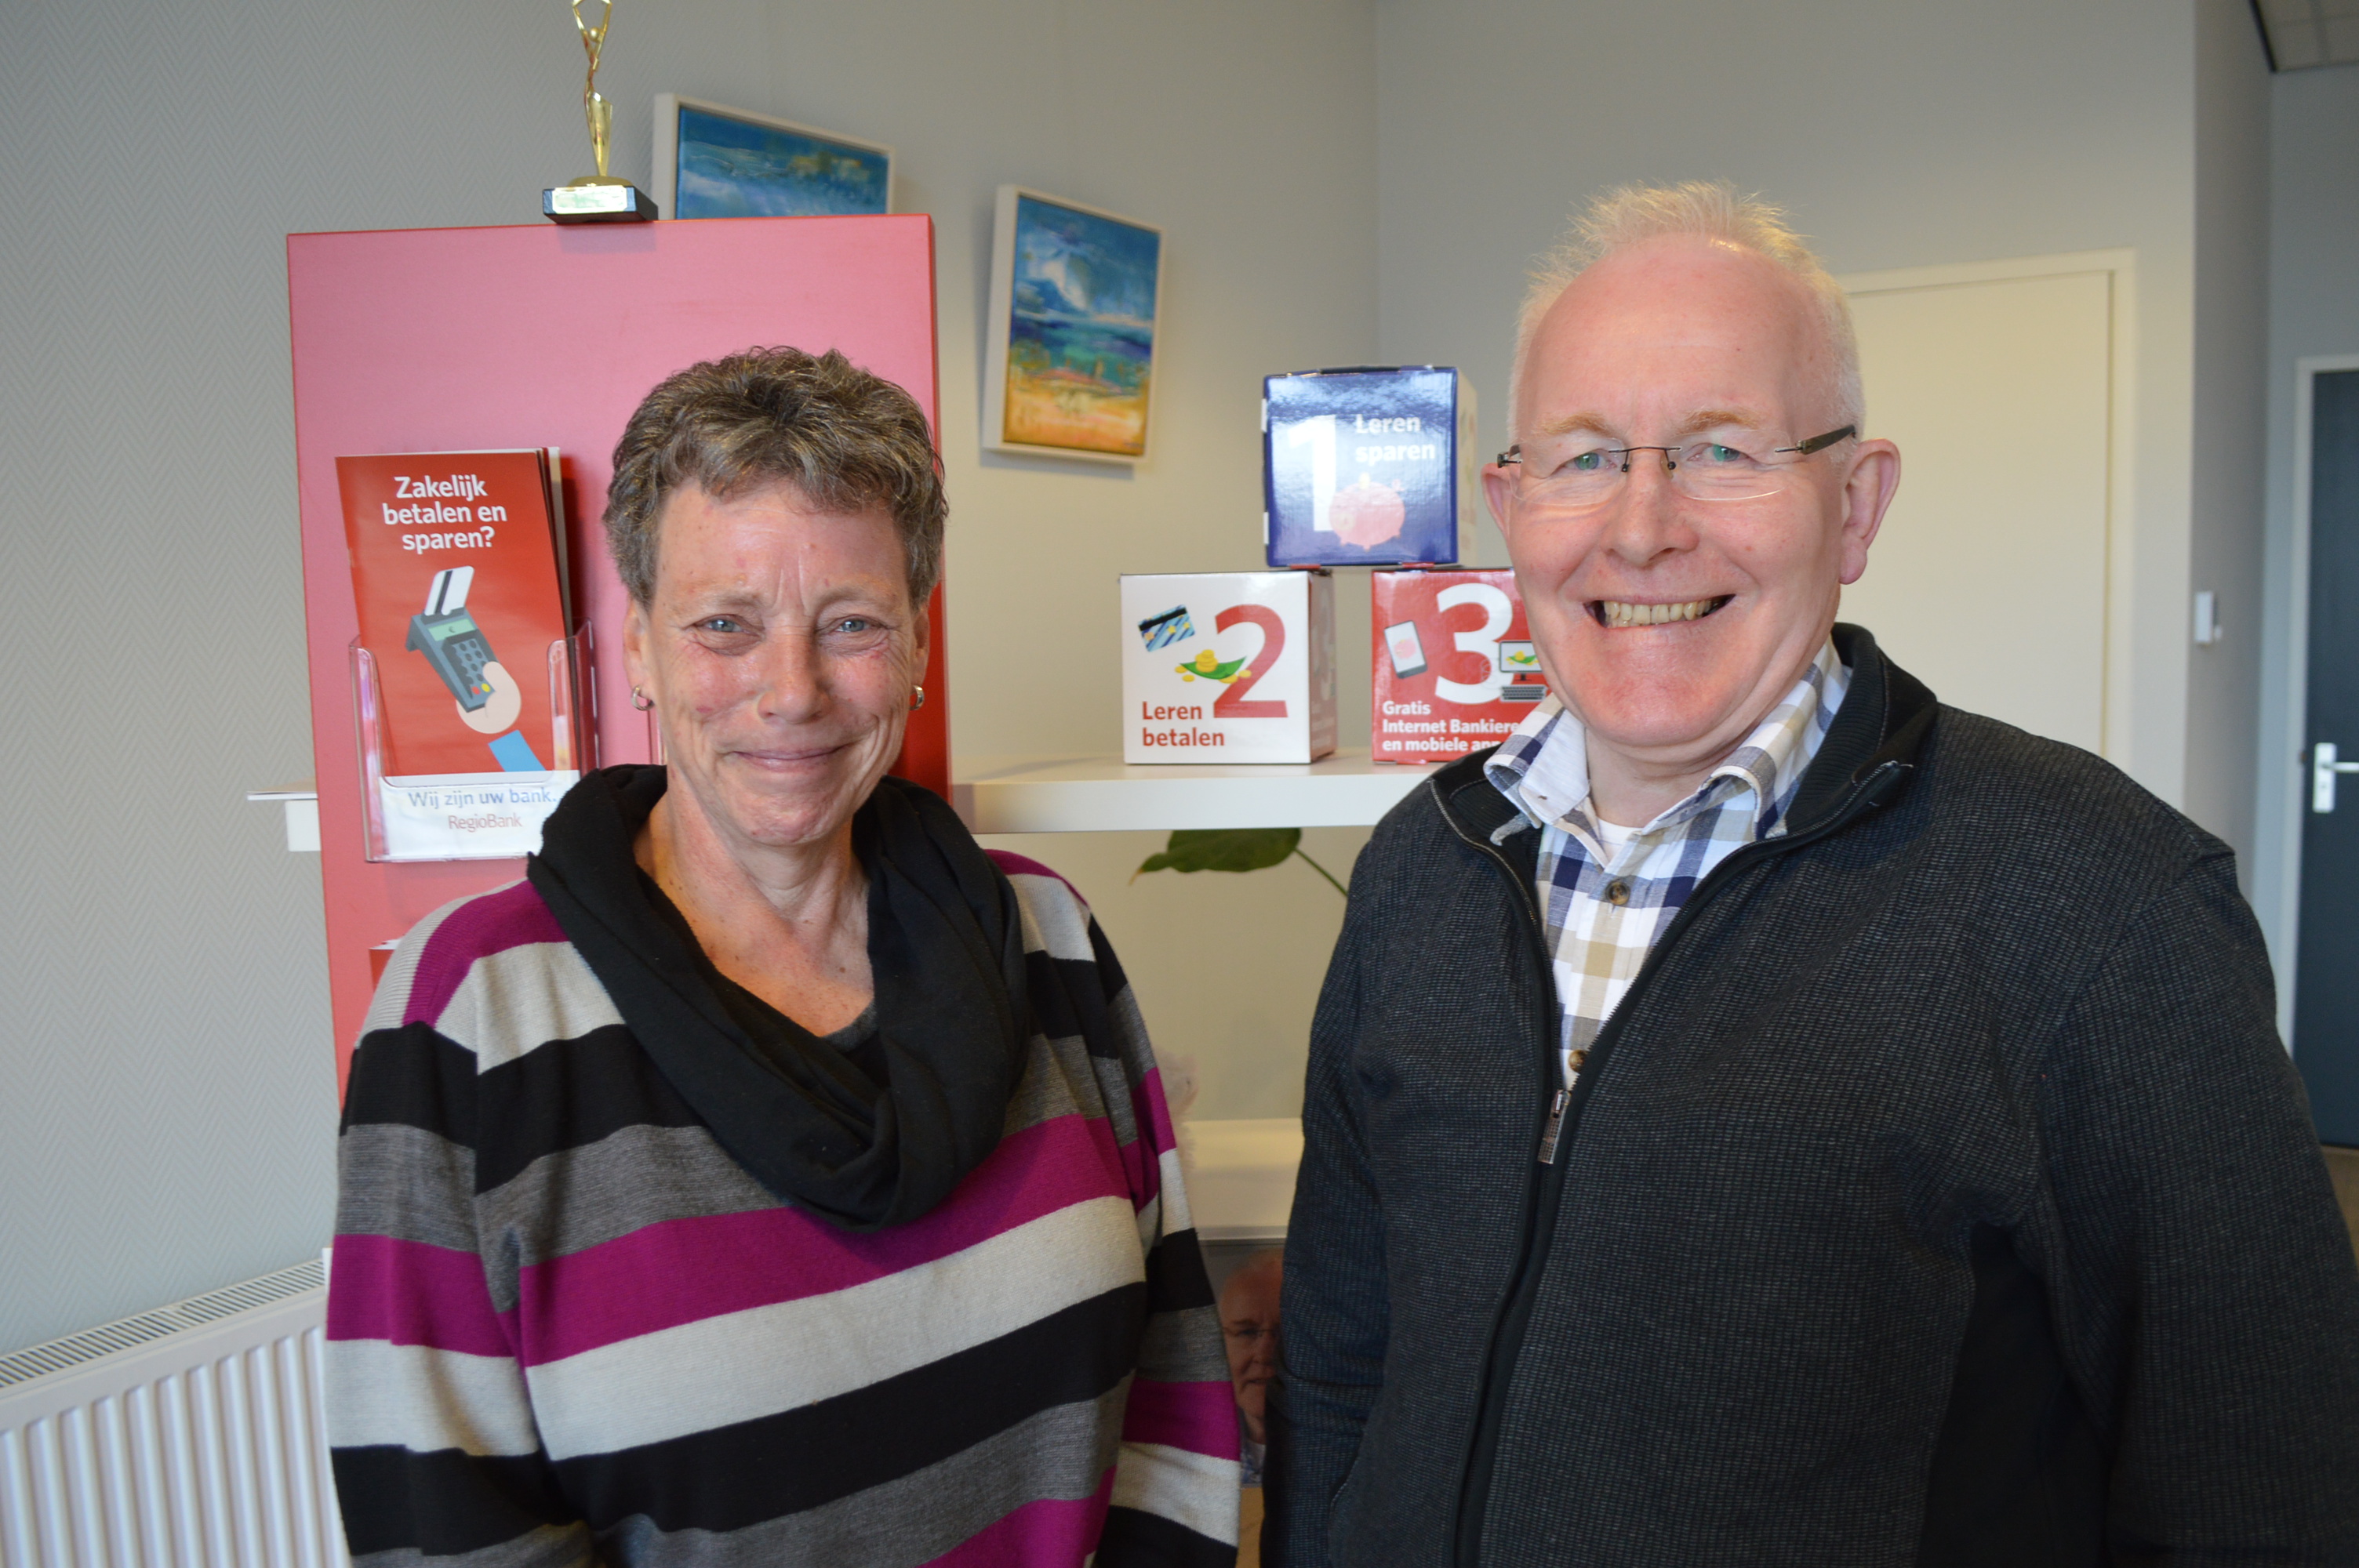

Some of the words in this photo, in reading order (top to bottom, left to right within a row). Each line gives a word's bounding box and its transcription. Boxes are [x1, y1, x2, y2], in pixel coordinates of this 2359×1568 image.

[1355, 413, 1422, 434] Leren
[1355, 443, 1436, 466] sparen
[1287, 414, 1336, 532] 1
[394, 474, 489, 502] Zakelijk
[382, 500, 472, 525] betalen
[477, 505, 508, 522] en
[402, 525, 495, 555] sparen?
[1435, 583, 1514, 704] 3
[1213, 604, 1289, 718] 2
[1142, 701, 1202, 720] Leren
[1382, 699, 1431, 715] Gratis
[1142, 727, 1225, 746] betalen
[1382, 719, 1447, 733] Internet
[1382, 740, 1401, 751] en
[1405, 737, 1469, 751] mobiele
[408, 791, 440, 809] Wij
[445, 790, 474, 808] zijn
[479, 792, 504, 804] uw
[510, 786, 558, 803] bank.
[448, 811, 523, 833] RegioBank
